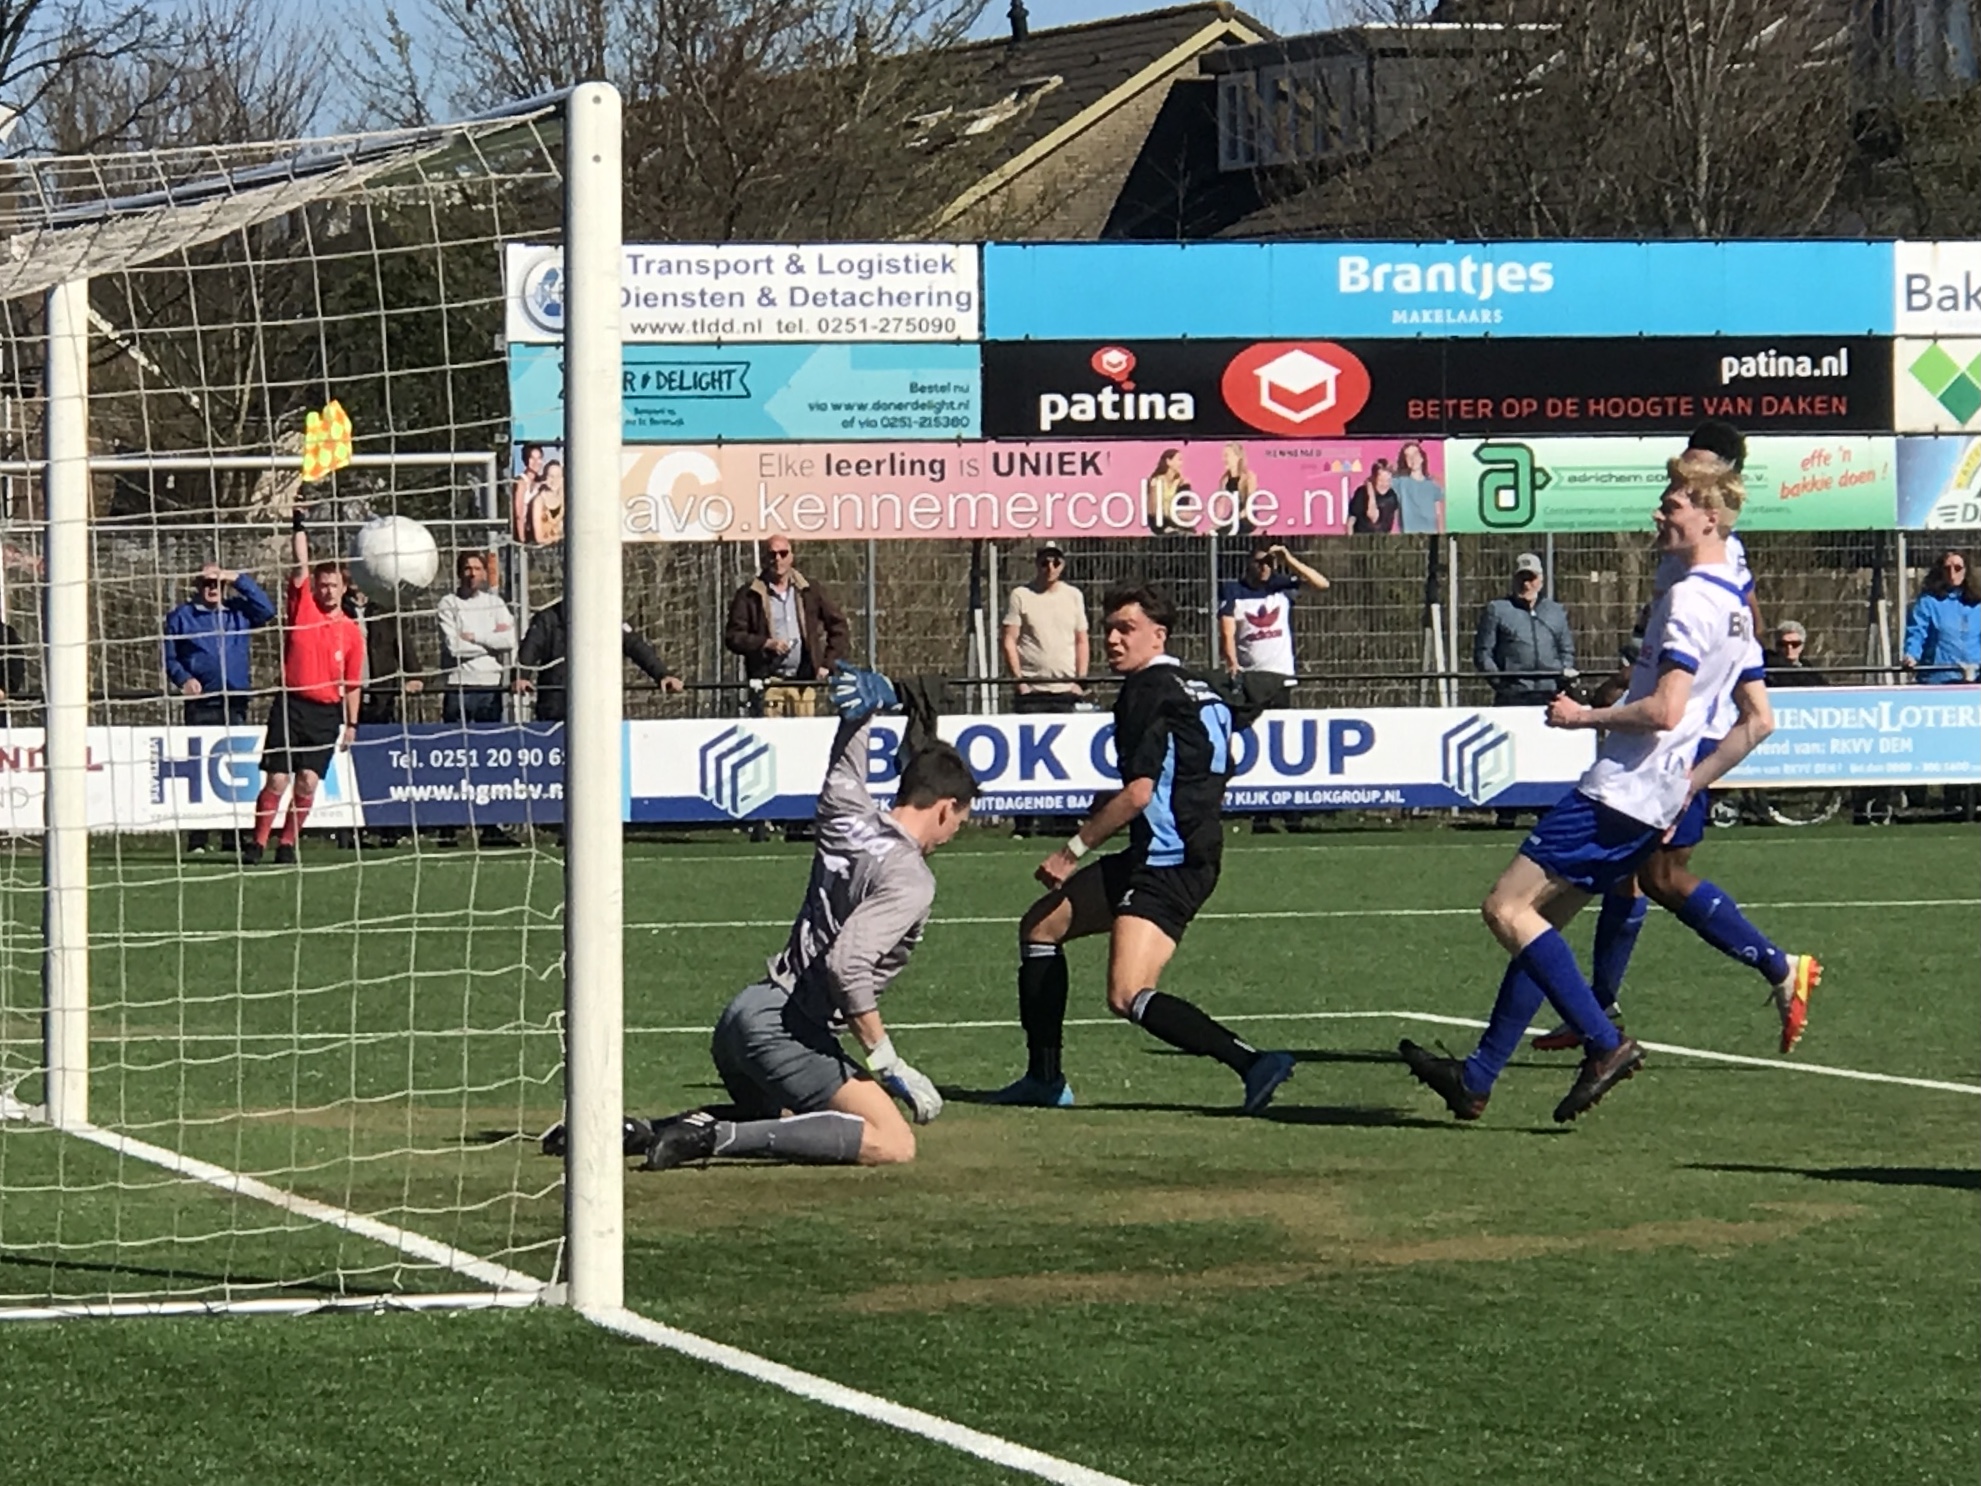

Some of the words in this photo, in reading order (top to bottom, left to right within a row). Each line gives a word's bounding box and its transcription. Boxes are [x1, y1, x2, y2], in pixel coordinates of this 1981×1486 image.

[626, 253, 774, 280] Transport
[785, 252, 805, 275] &
[818, 252, 956, 280] Logistiek
[1339, 254, 1554, 300] Brantjes
[757, 285, 777, 308] &
[790, 284, 972, 312] Detachering
[1906, 270, 1981, 312] Bak
[631, 317, 762, 334] www.tldd.nl
[777, 317, 809, 334] tel.
[818, 317, 956, 334] 0251-275090
[1391, 308, 1504, 325] MAKELAARS
[1721, 348, 1848, 385] patina.nl
[655, 369, 737, 391] DELIGHT
[909, 381, 951, 394] Bestel
[953, 384, 970, 394] nu
[1040, 386, 1195, 430] patina
[1408, 400, 1494, 419] BETER
[1502, 399, 1538, 418] OP
[1546, 398, 1580, 418] DE
[1588, 397, 1694, 418] HOOGTE
[1703, 396, 1753, 416] VAN
[1761, 396, 1848, 416] DAKEN
[759, 452, 816, 478] Elke
[825, 452, 946, 482] leerling
[958, 452, 981, 477] is
[1801, 448, 1832, 471] effe
[1567, 473, 1642, 484] adrichem
[1779, 474, 1833, 500] bakkie
[1838, 469, 1876, 488] doen
[389, 750, 424, 768] Tel.
[430, 749, 479, 767] 0251
[486, 749, 512, 767] 20
[518, 748, 543, 767] 90
[868, 724, 1070, 783] BOK
[1830, 737, 1873, 755] RKVV
[1879, 737, 1914, 754] DEM
[390, 777, 563, 805] www.hgmbv.n
[970, 795, 1063, 811] UITDAGENDE
[1235, 791, 1270, 806] KIJK
[1272, 790, 1292, 805] OP
[1294, 789, 1405, 805] BLOKGROUP.NL
